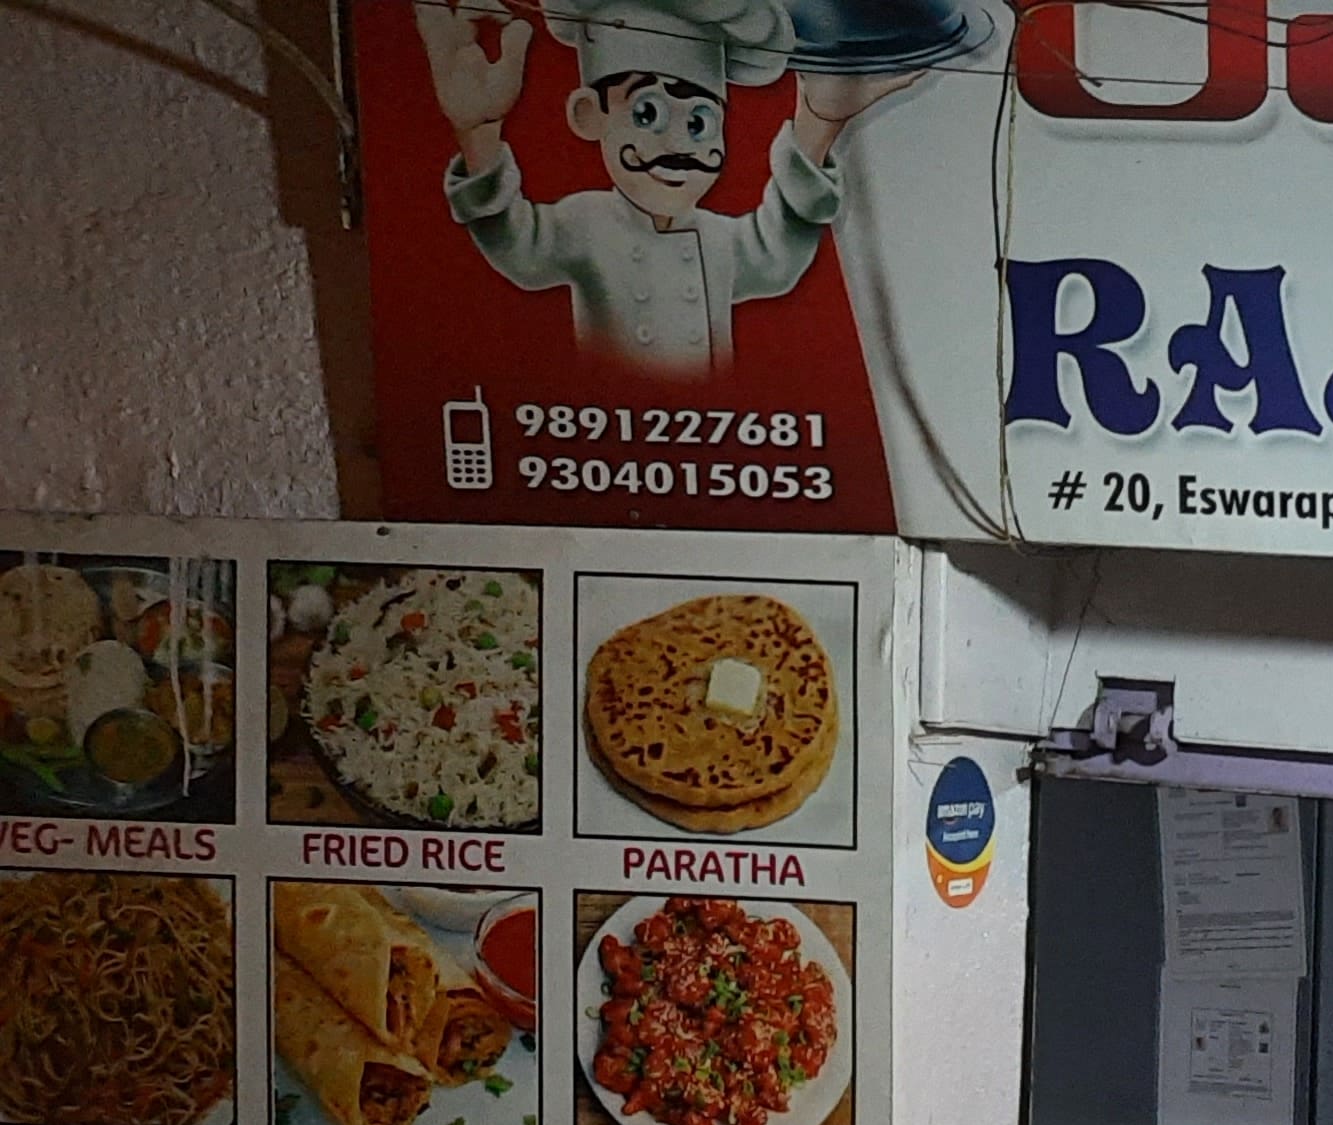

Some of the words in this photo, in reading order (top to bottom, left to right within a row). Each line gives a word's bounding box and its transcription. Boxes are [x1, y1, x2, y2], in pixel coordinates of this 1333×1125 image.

[515, 403, 826, 448] 9891227681
[518, 456, 833, 500] 9304015053
[1048, 471, 1087, 511] #
[1103, 471, 1165, 522] 20,
[87, 824, 216, 862] MEALS
[302, 833, 409, 872] FRIED
[420, 837, 506, 874] RICE
[623, 846, 807, 888] PARATHA
